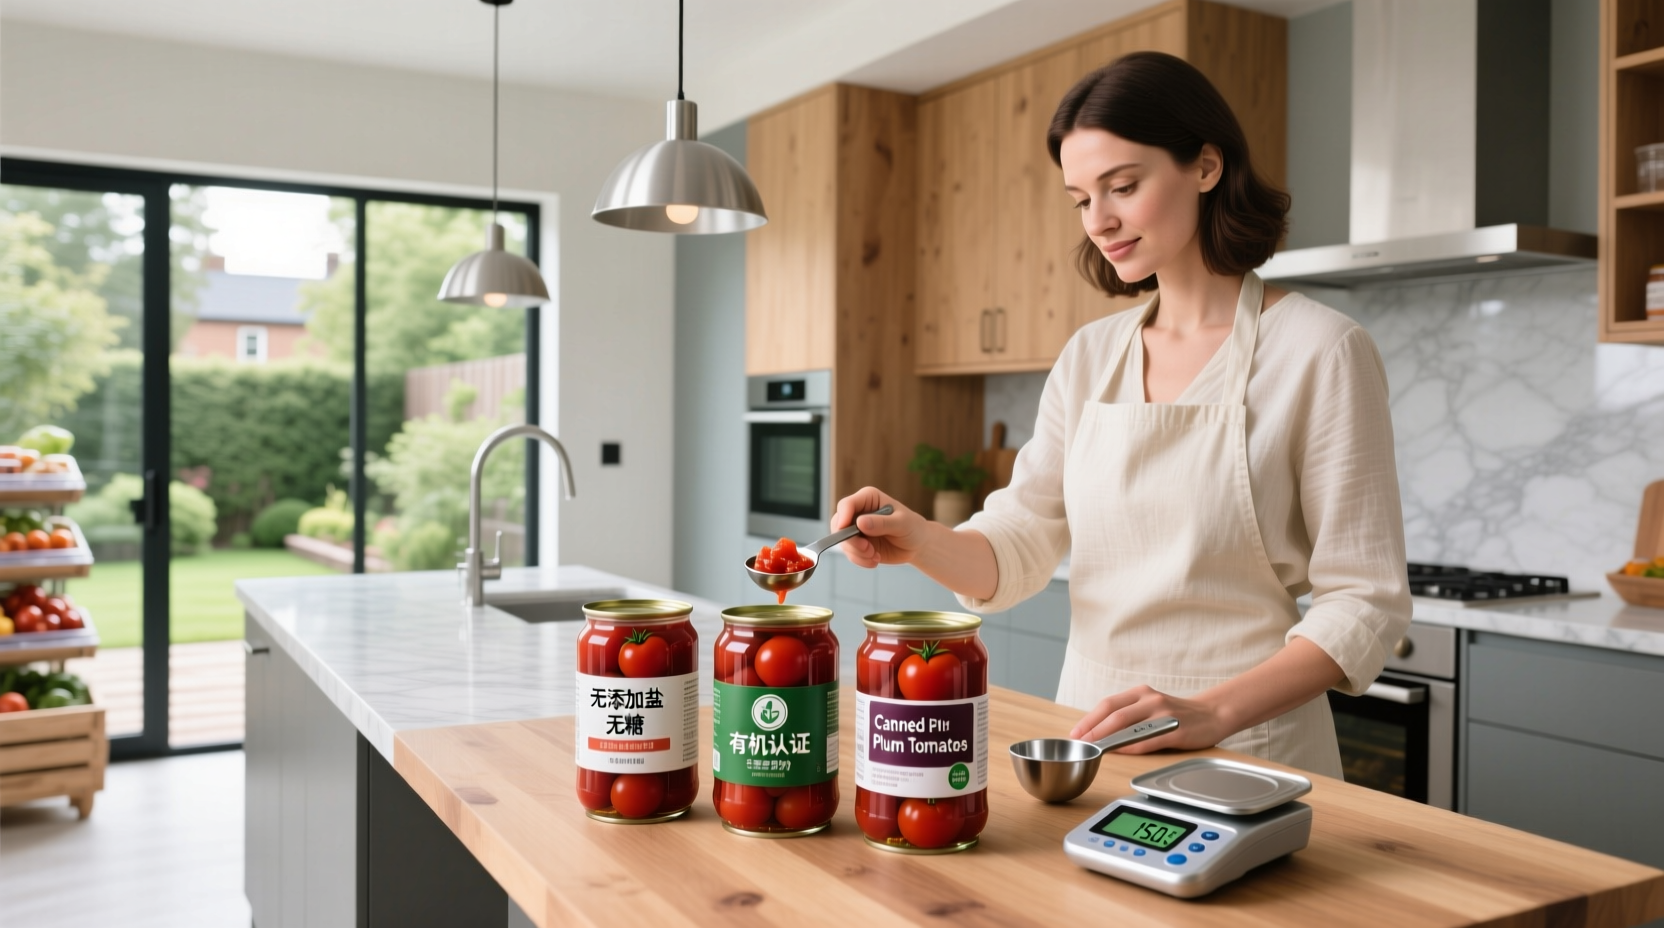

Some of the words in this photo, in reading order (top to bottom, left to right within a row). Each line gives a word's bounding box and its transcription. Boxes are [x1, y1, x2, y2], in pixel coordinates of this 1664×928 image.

[590, 687, 664, 710] 无添加盐
[606, 713, 645, 736] 无糖
[874, 714, 925, 733] Canned
[729, 731, 811, 756] 有机认证
[873, 733, 904, 753] Plum
